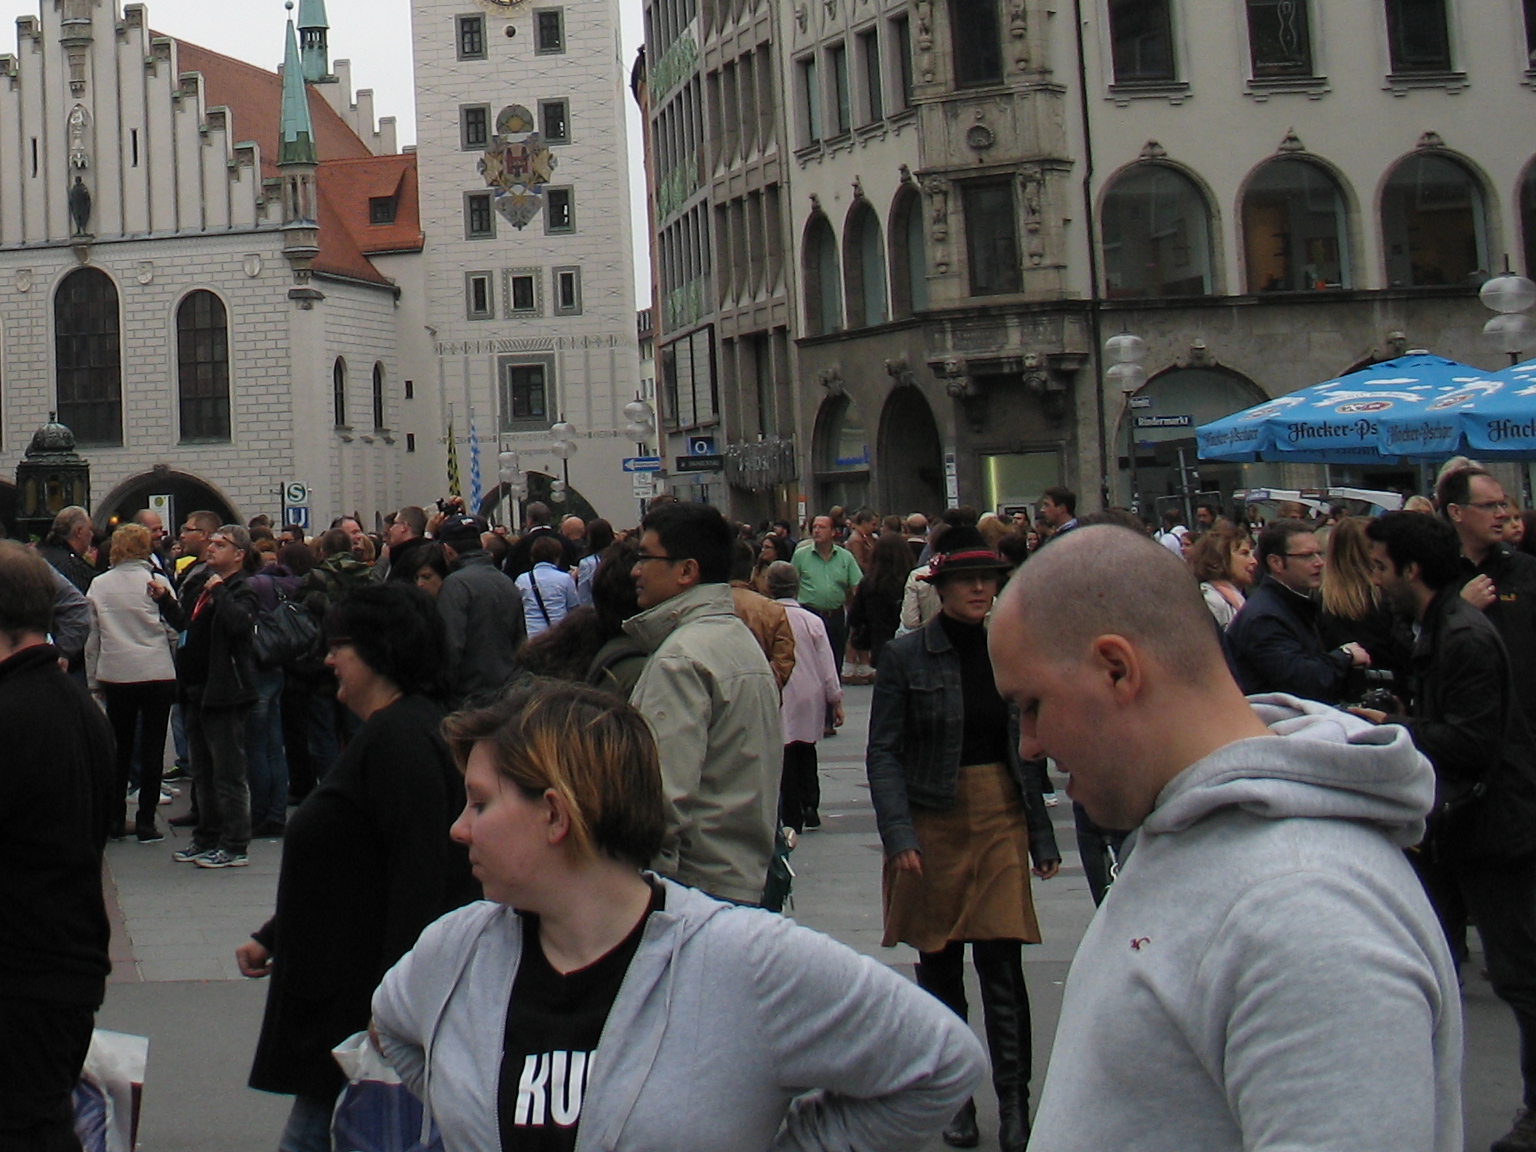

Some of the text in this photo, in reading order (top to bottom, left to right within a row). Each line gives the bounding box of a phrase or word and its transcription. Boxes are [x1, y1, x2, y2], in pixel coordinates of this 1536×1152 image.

[1287, 418, 1378, 443] Hacker-Ps
[289, 507, 306, 527] U
[514, 1050, 596, 1126] KU
